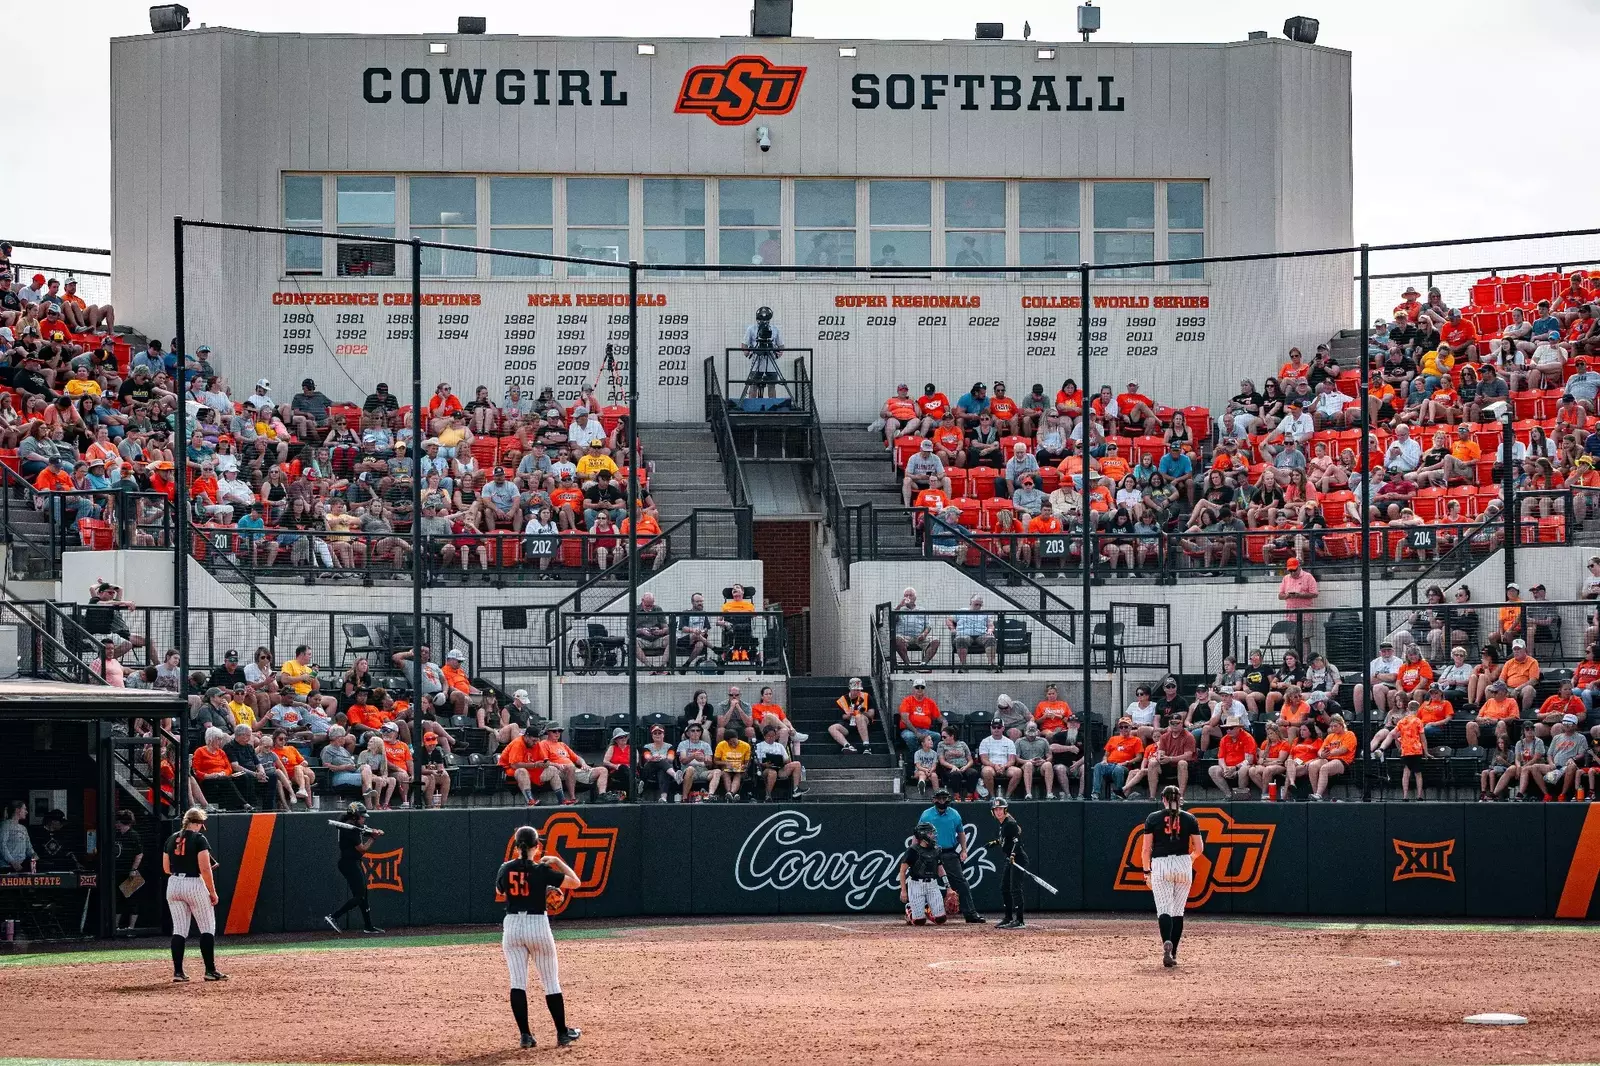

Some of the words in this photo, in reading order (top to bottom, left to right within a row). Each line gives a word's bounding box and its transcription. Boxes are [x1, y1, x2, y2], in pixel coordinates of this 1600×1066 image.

[362, 66, 628, 107] COWGIRL
[851, 72, 1125, 112] SOFTBALL
[680, 58, 802, 121] OSU
[272, 292, 379, 306] CONFERENCE
[382, 293, 481, 306] CHAMPIONS
[527, 293, 572, 307] NCAA
[834, 295, 888, 308] SUPER
[891, 295, 981, 309] REGIONALS
[1021, 296, 1085, 309] COLLEG
[1092, 296, 1150, 309] WORLD
[1153, 296, 1210, 309] SERIES
[282, 313, 314, 324] 1980
[335, 313, 365, 324] 1981
[437, 314, 469, 324] 1990
[504, 314, 535, 325] 1982
[556, 314, 588, 325] 1984
[607, 314, 638, 325] 198
[658, 314, 689, 325] 1989
[818, 315, 846, 326] 2011
[866, 316, 897, 326] 2019
[917, 316, 947, 327] 2021
[968, 316, 1000, 327] 2022
[1026, 316, 1057, 327] 1982
[1076, 317, 1107, 327] 189
[1126, 317, 1156, 327] 1990
[1175, 316, 1206, 327] 1993
[282, 328, 312, 339] 1991
[335, 329, 367, 340] 1992
[437, 329, 469, 340] 1994
[504, 329, 536, 340] 1990
[556, 330, 586, 340] 1991
[607, 330, 638, 340] 199
[658, 330, 689, 340] 1993
[818, 331, 850, 341] 2023
[1026, 331, 1057, 341] 1994
[1076, 331, 1108, 341] 198
[1126, 331, 1154, 341] 2011
[1175, 331, 1206, 342] 2019
[282, 344, 314, 355] 1995
[335, 344, 369, 355] 2022
[504, 345, 536, 355] 1996
[556, 345, 587, 355] 1997
[658, 345, 691, 355] 2003
[1026, 346, 1056, 356] 2021
[1126, 346, 1158, 356] 2023
[504, 360, 537, 371] 2005
[557, 361, 590, 371] 2009
[658, 360, 687, 371] 2011
[504, 375, 535, 386] 2016
[557, 376, 587, 386] 2017
[607, 376, 638, 386] 201
[658, 376, 689, 386] 2019
[557, 391, 590, 401] 202
[214, 533, 228, 549] 201
[1413, 531, 1432, 546] 204
[532, 540, 552, 555] 202
[1045, 539, 1065, 554] 203
[1397, 842, 1452, 878] XII
[0, 877, 32, 887] AHOMA
[33, 876, 61, 886] STATE
[508, 871, 530, 896] 55
